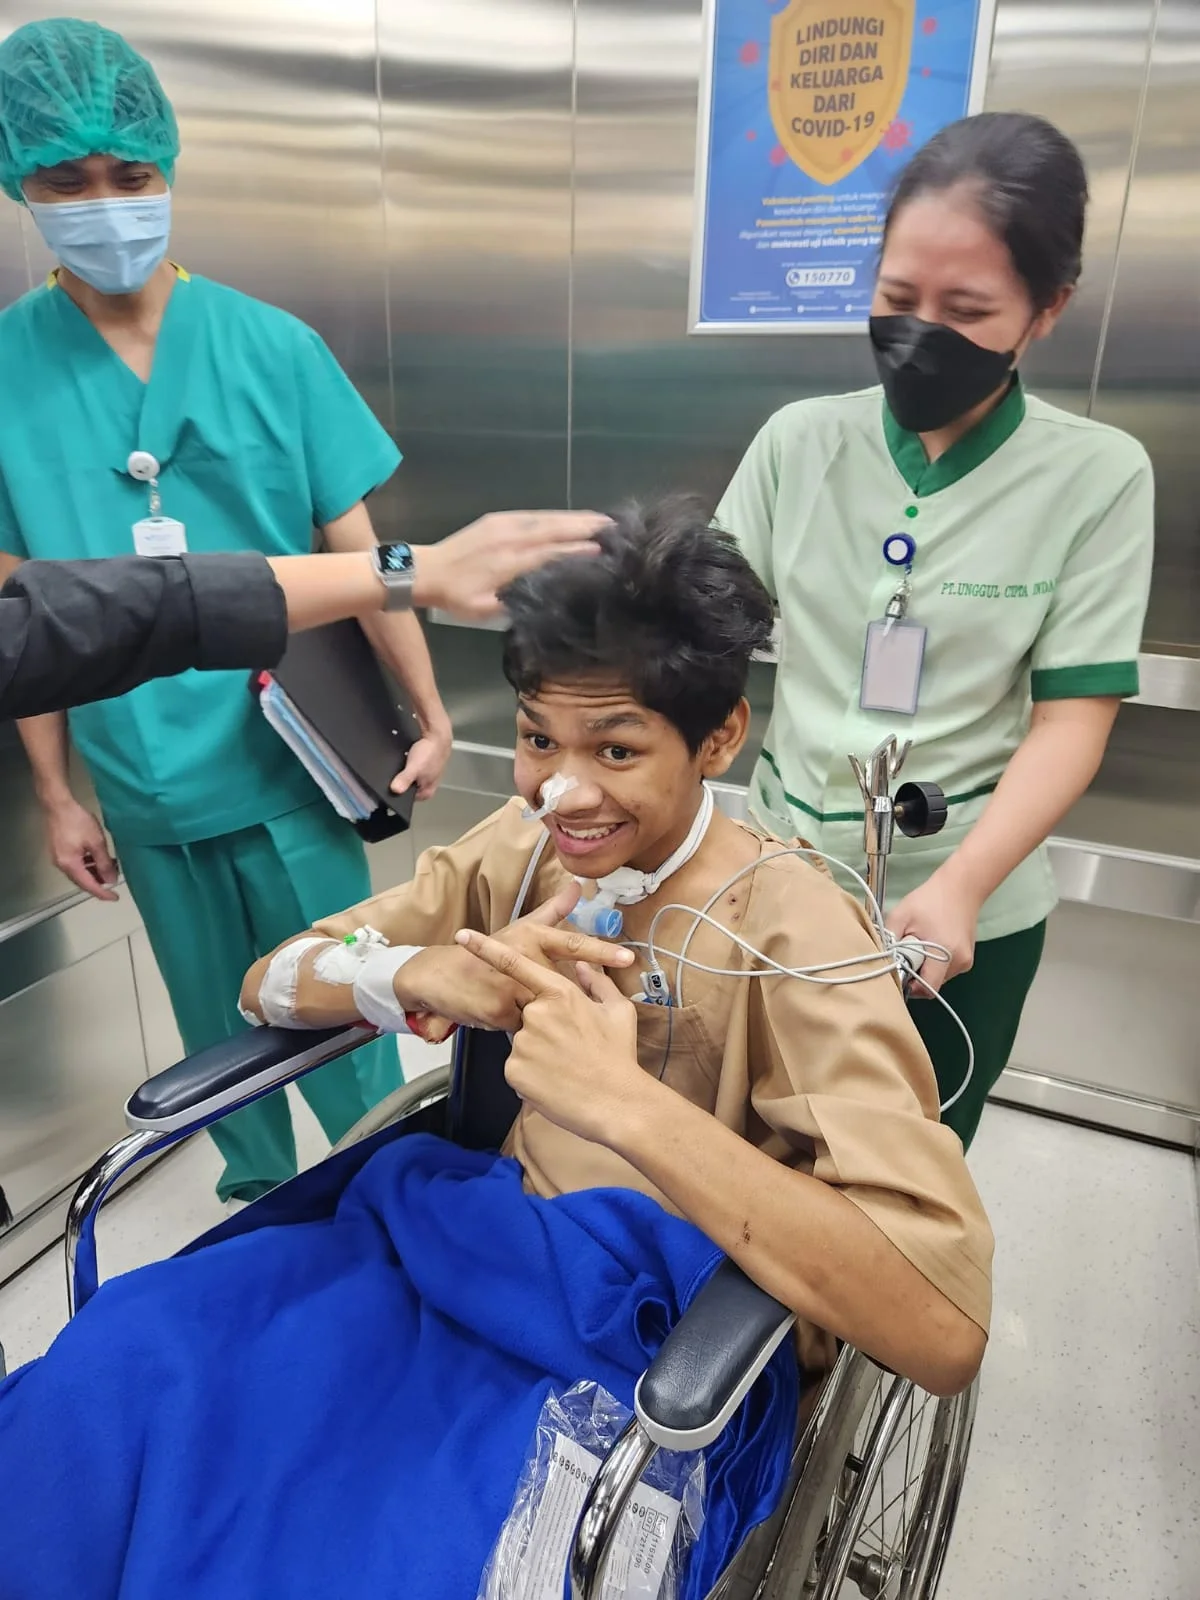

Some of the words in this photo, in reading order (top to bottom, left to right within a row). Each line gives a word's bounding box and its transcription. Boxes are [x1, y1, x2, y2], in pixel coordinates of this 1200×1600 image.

[796, 16, 884, 46] LINDUNGI
[799, 44, 836, 66] DIRI
[839, 42, 878, 61] DAN
[790, 65, 884, 89] KELUARGA
[813, 92, 855, 113] DARI
[791, 111, 875, 138] COVID-19
[804, 271, 850, 282] 150770
